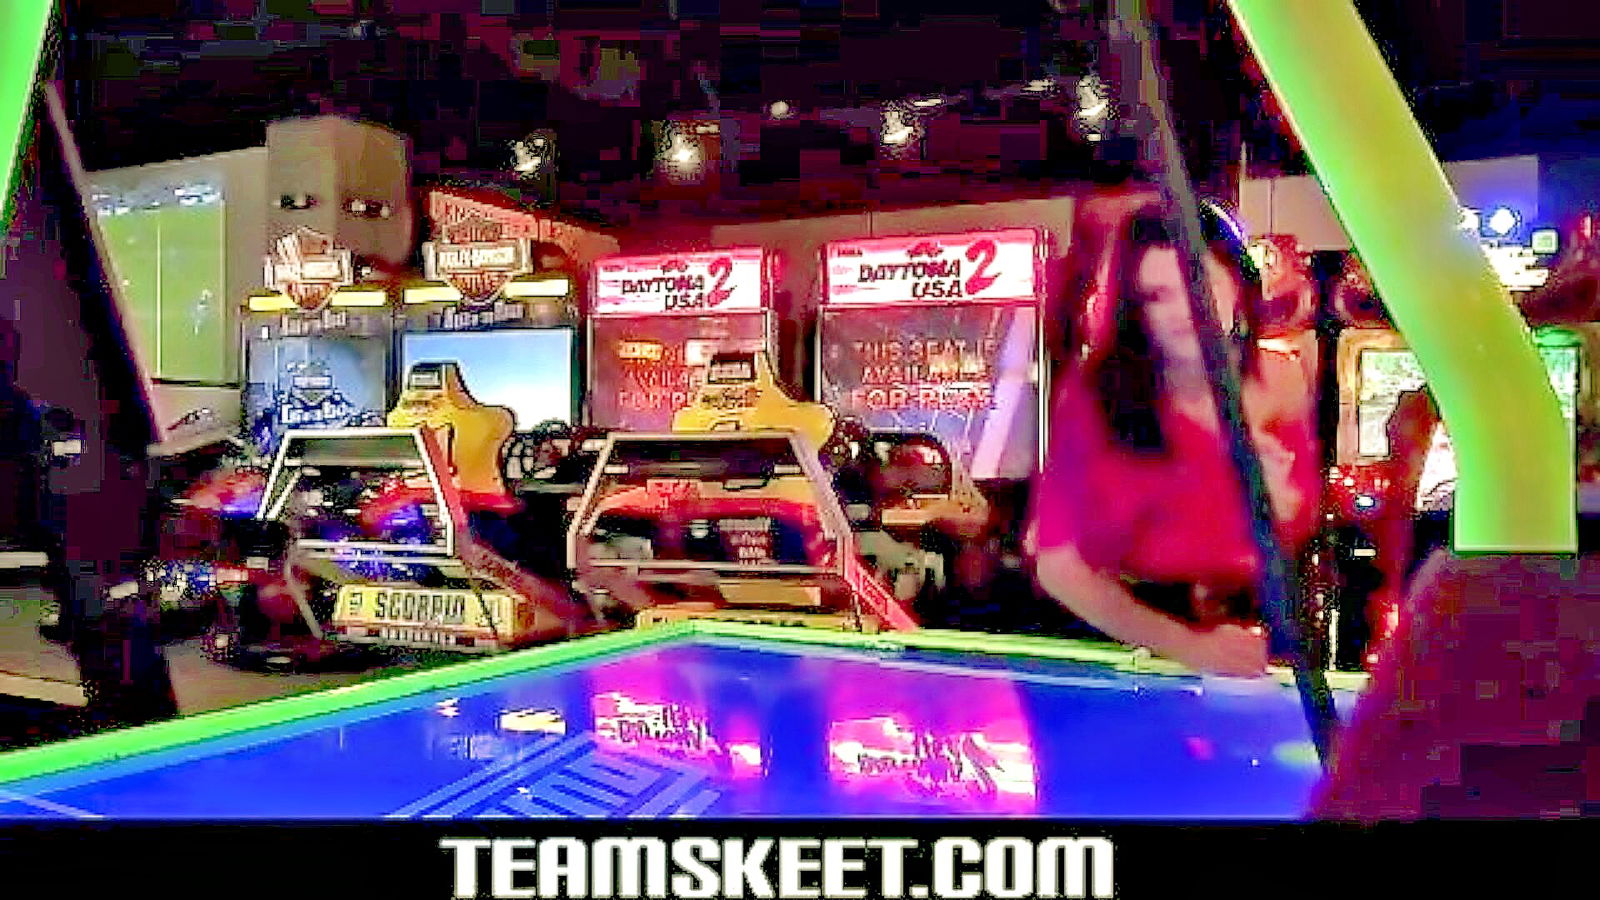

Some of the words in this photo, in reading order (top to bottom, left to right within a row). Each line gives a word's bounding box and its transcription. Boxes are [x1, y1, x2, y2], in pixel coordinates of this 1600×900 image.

[858, 259, 961, 282] DAYTONA
[965, 239, 1001, 295] 2
[622, 275, 705, 295] DAYTONA
[707, 256, 738, 307] 2
[912, 280, 963, 299] USA
[665, 292, 705, 310] USA
[910, 341, 968, 362] SEAT
[852, 387, 909, 411] FOR
